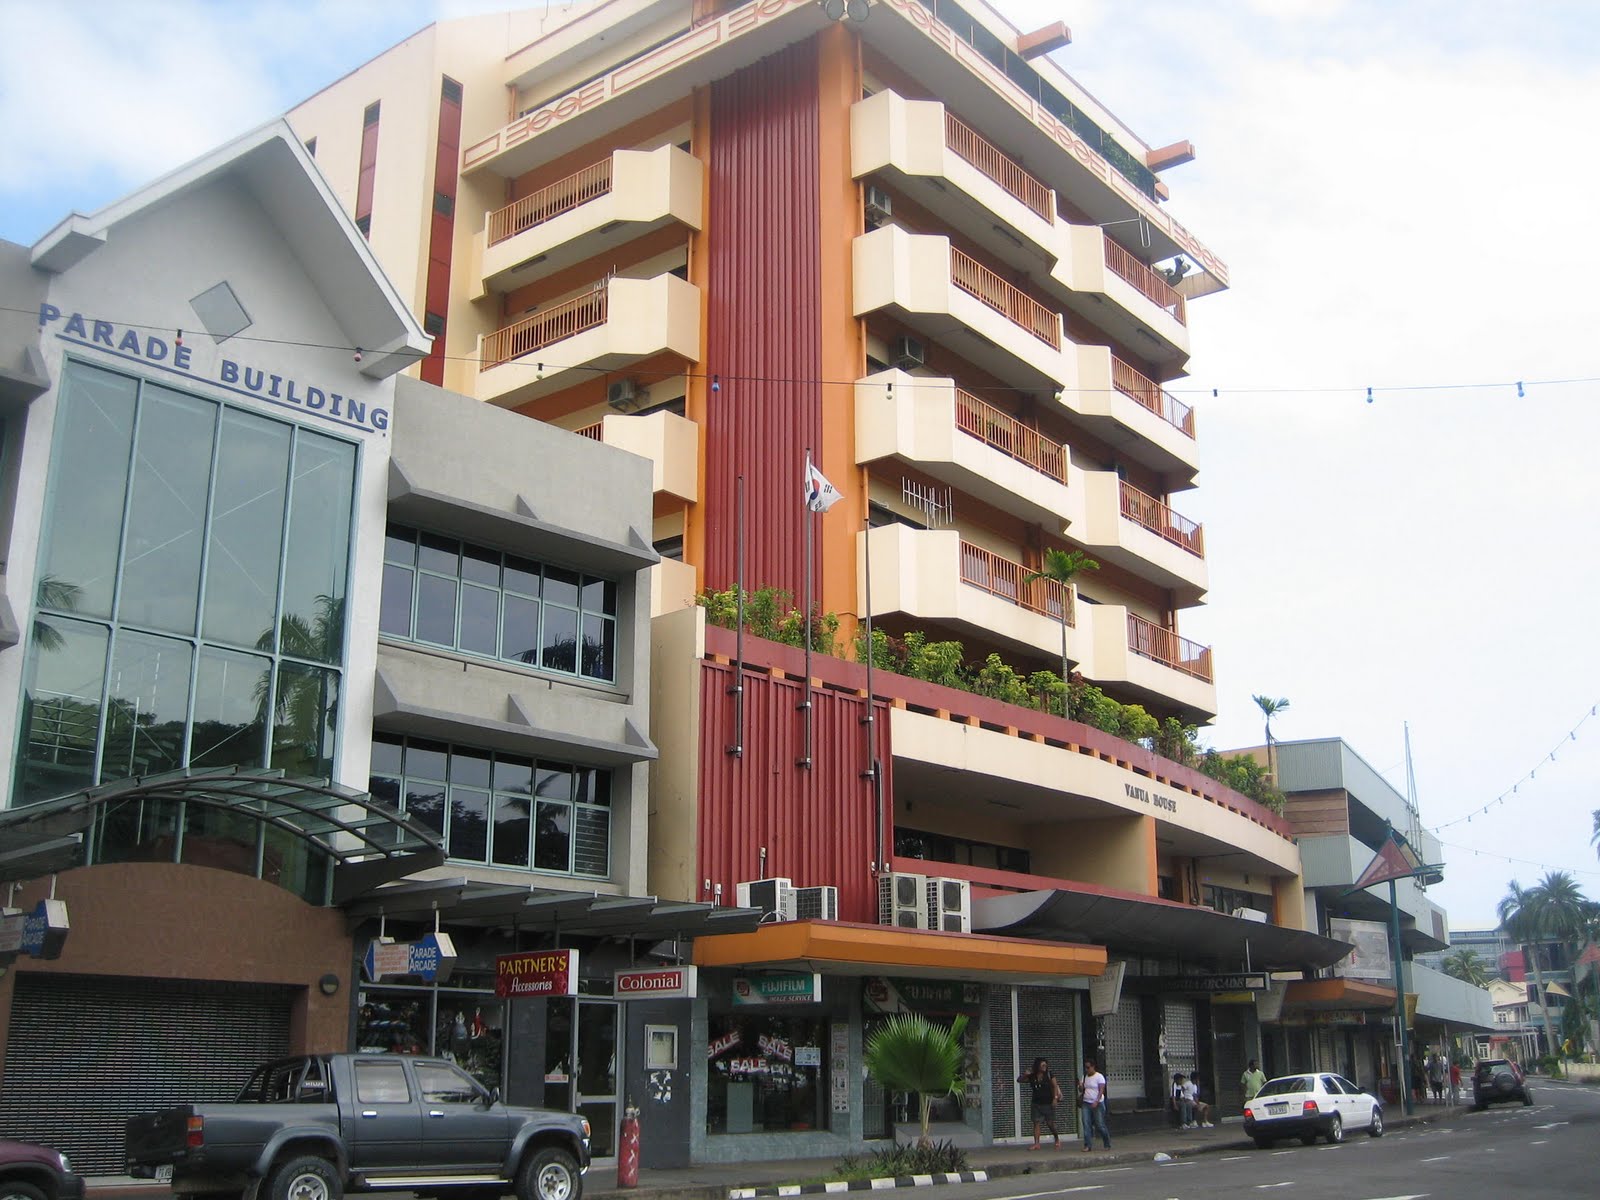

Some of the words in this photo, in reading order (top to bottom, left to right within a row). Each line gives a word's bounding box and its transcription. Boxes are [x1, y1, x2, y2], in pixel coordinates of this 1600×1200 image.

[39, 303, 192, 370] PARADE
[220, 359, 389, 431] BUILDING
[1124, 783, 1150, 803] VANUA
[1153, 793, 1177, 813] HOUSE
[409, 945, 437, 959] PARADE
[408, 959, 437, 972] ARCADE
[500, 955, 567, 975] PARTNER'S
[510, 976, 553, 993] Accessories
[619, 974, 679, 990] Colonial
[762, 980, 805, 993] FUJIFILM
[707, 1031, 741, 1059] SALE
[758, 1035, 793, 1060] SALE
[731, 1059, 767, 1073] SALE
